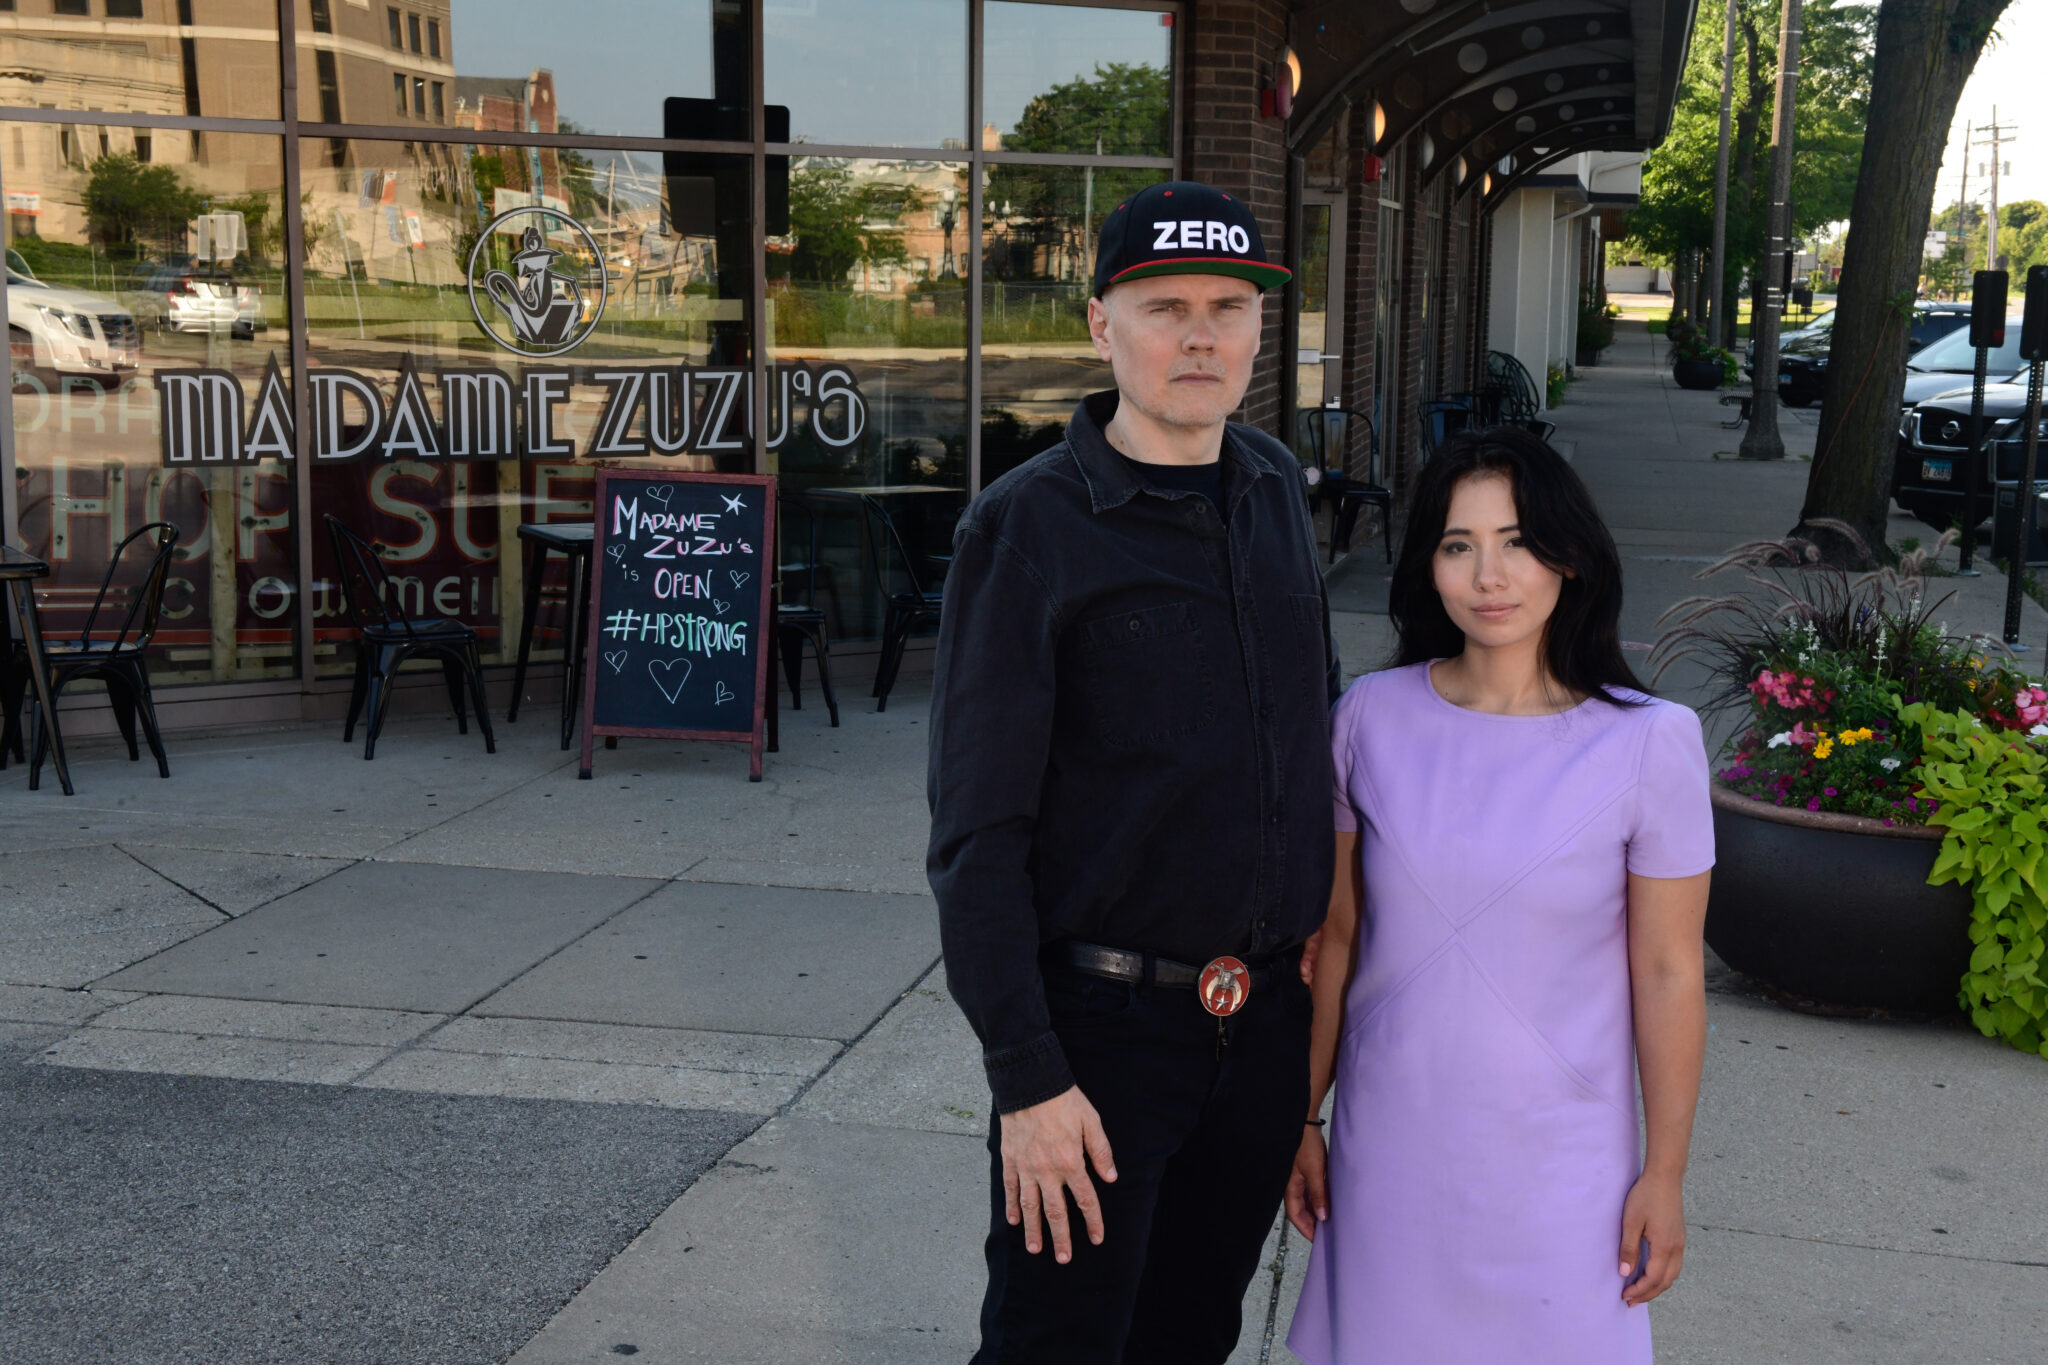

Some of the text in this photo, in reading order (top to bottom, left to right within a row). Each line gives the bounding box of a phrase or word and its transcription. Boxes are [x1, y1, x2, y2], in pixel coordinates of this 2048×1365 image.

[1153, 220, 1250, 254] ZERO
[158, 366, 868, 464] MADAME ZUZU'S
[16, 456, 598, 564] HOP SUE
[612, 495, 721, 541] MADAME
[621, 563, 713, 599] is OPEN
